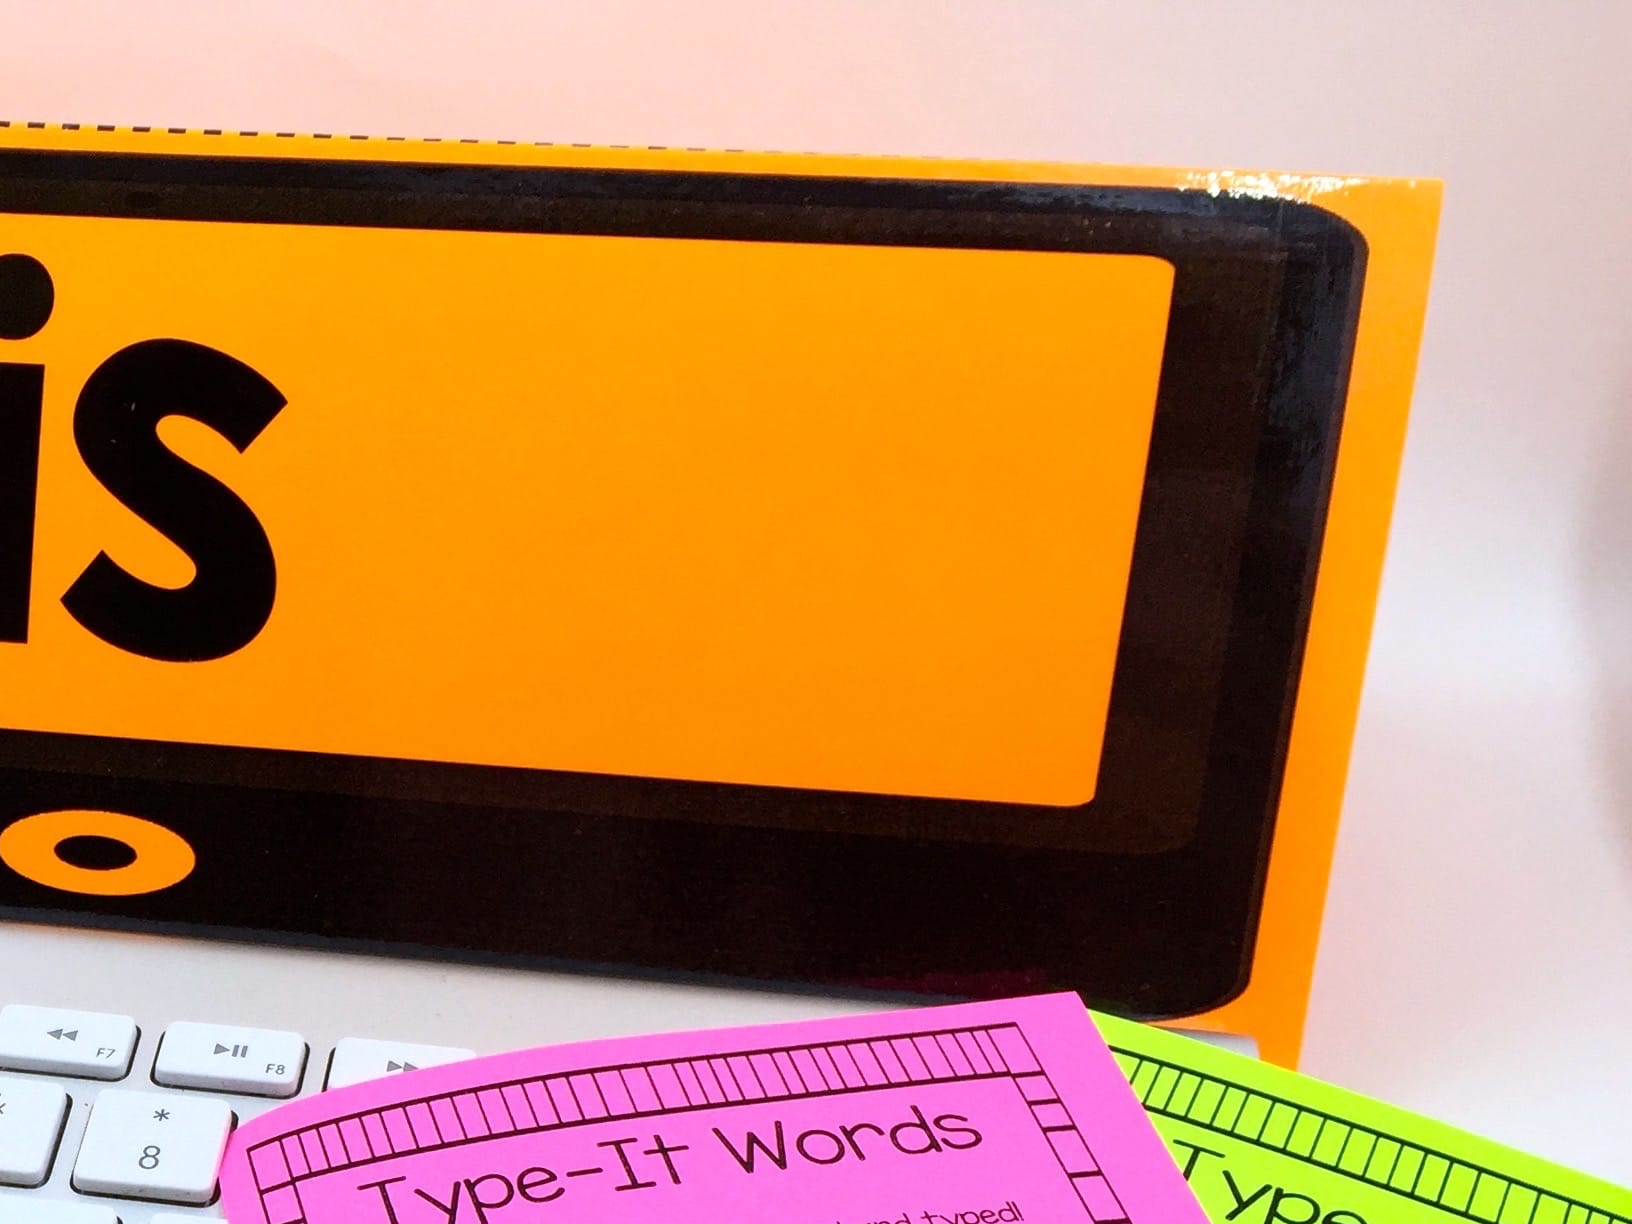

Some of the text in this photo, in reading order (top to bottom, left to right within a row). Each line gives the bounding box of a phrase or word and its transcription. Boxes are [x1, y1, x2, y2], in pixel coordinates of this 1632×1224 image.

[95, 1047, 116, 1059] F7
[265, 1063, 286, 1076] F8
[712, 1104, 984, 1175] Words
[138, 1145, 161, 1170] 8
